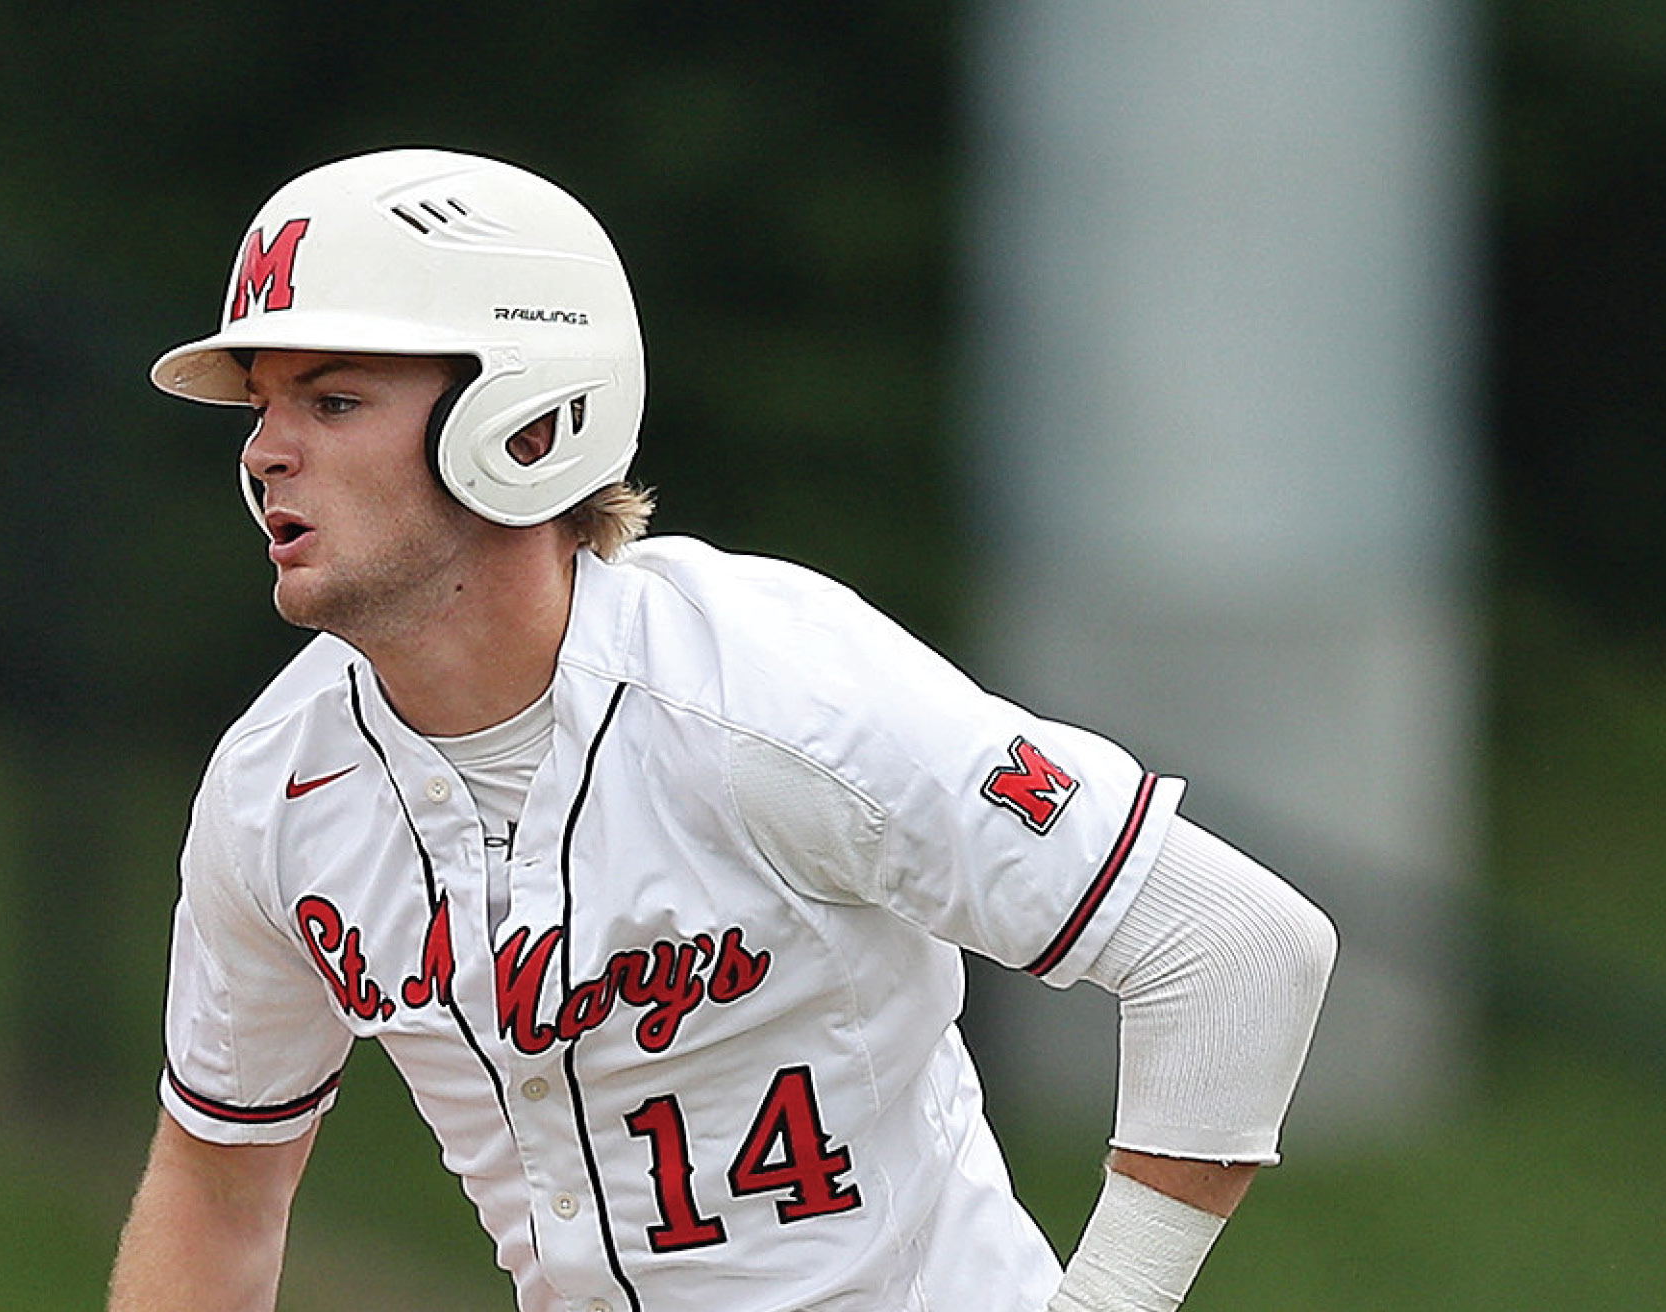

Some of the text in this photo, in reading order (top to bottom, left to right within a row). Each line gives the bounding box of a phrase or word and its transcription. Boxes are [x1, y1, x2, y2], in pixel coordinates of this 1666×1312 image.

[229, 218, 311, 323] M
[493, 308, 589, 325] RAWLINGS
[980, 735, 1080, 836] M
[296, 895, 396, 1023] St.
[624, 1064, 862, 1254] 14
